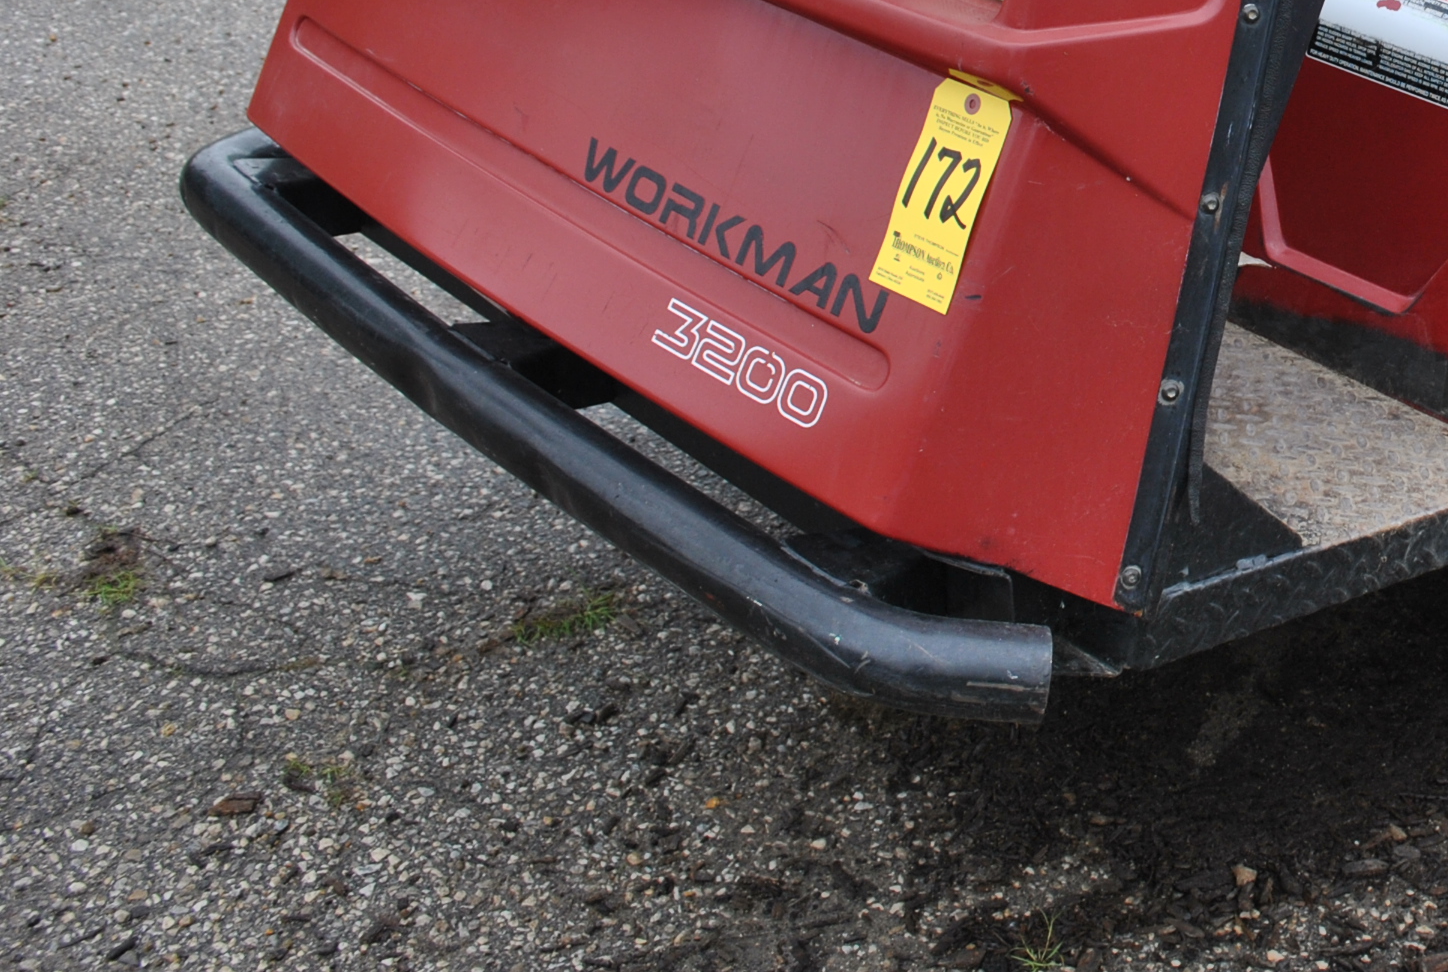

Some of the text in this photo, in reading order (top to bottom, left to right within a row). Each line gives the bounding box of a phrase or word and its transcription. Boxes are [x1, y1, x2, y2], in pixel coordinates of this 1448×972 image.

[584, 136, 890, 334] WORKMAN
[901, 136, 982, 230] 172
[651, 297, 828, 428] 3200
